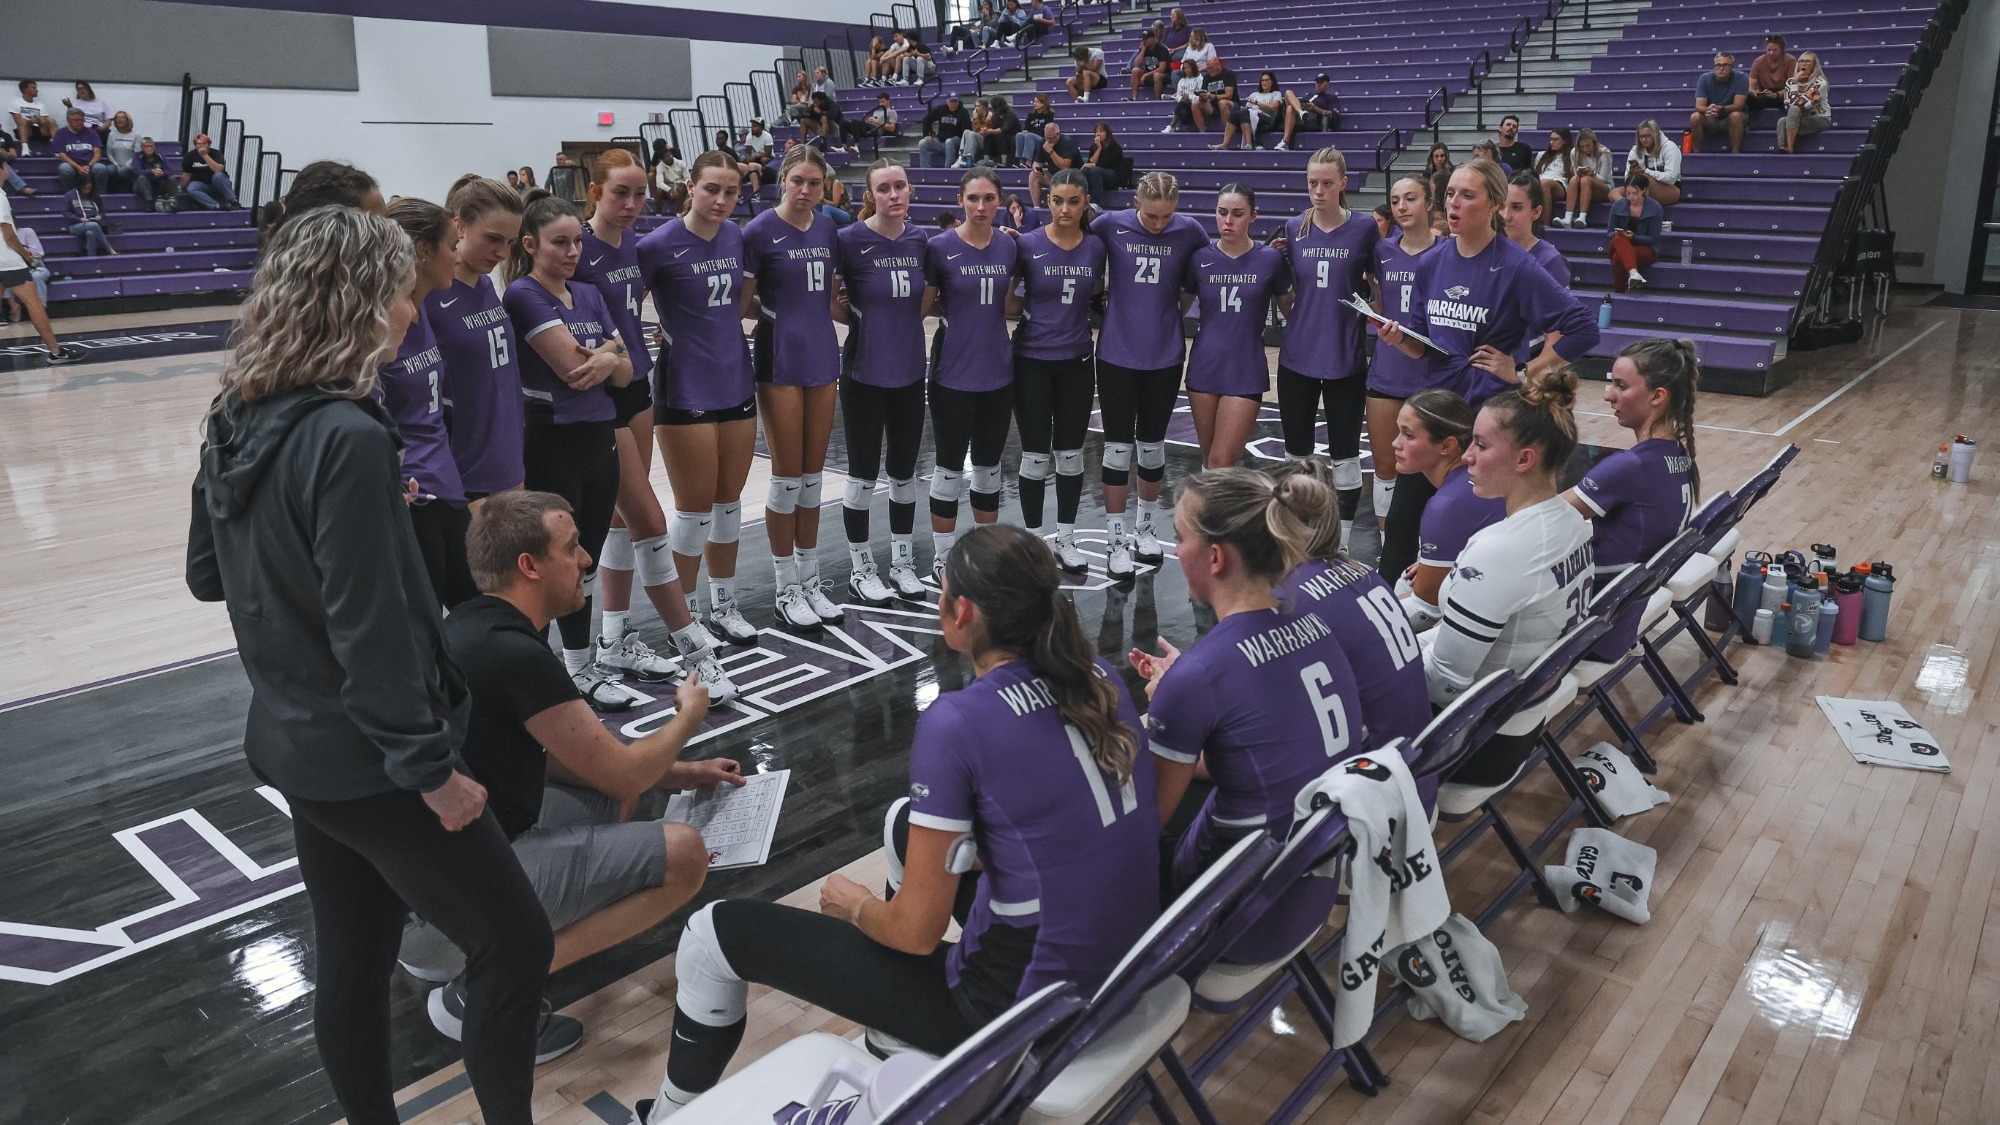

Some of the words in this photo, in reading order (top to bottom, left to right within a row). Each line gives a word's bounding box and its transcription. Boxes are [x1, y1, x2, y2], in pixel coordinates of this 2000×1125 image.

[787, 246, 830, 260] WHITEWATER
[873, 256, 919, 268] WHITEWATER
[1126, 243, 1172, 256] WHITEWATER
[1302, 247, 1350, 258] WHITEWATER
[690, 257, 738, 275] WHITEWATER
[806, 261, 825, 292] 19
[960, 264, 1007, 275] WHITEWATER
[1044, 265, 1093, 277] WHITEWATER
[1134, 256, 1161, 284] 23
[1209, 273, 1257, 284] WHITEWATER
[1316, 260, 1329, 288] 9
[707, 273, 732, 307] 22
[890, 270, 911, 298] 16
[980, 277, 993, 305] 11
[1061, 278, 1076, 305] 5
[1400, 284, 1413, 312] 8
[626, 283, 639, 316] 4
[1219, 286, 1242, 313] 14
[1427, 298, 1490, 324] WARHAWK
[487, 325, 510, 369] 15
[428, 370, 439, 414] 3
[1356, 585, 1420, 672] 18
[1300, 661, 1350, 758] 6
